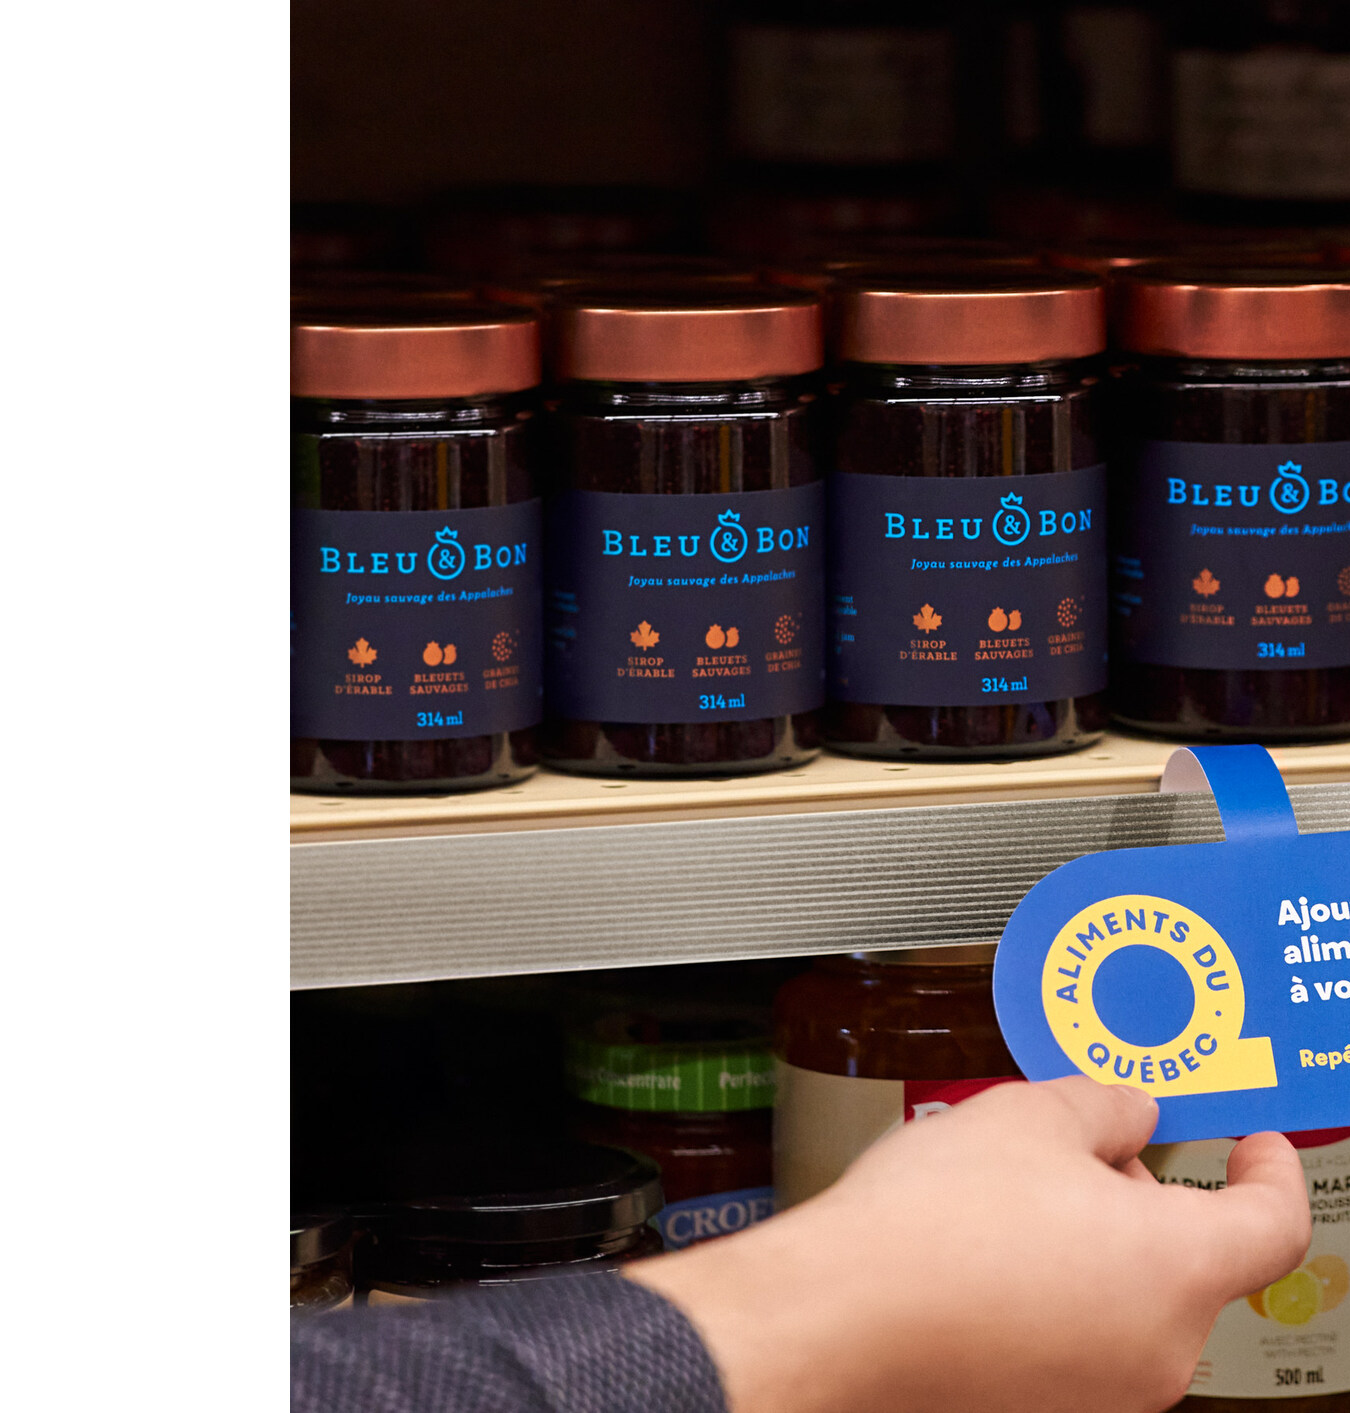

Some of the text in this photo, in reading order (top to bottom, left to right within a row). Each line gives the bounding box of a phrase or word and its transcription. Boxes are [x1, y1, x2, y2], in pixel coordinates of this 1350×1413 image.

[1166, 477, 1261, 507] BLEU
[884, 512, 983, 540] BLEU
[1039, 509, 1092, 536] BON
[602, 529, 700, 557] BLEU
[756, 526, 810, 554] BON
[320, 546, 418, 574] BLEU
[473, 543, 528, 571] BON
[911, 558, 946, 571] Joyau
[949, 559, 999, 571] sauvage
[1002, 556, 1021, 568] des
[628, 575, 664, 588] Joyau
[666, 576, 716, 588] sauvage
[719, 573, 739, 585] des
[346, 592, 381, 605] Joyau
[384, 592, 433, 605] sauvage
[437, 590, 456, 602] des
[910, 639, 947, 649] SIROP
[979, 637, 1031, 649] BLEUETS
[1257, 642, 1305, 658] 314 ml
[627, 656, 664, 667] SIROP
[696, 654, 748, 666] BLEUETS
[974, 649, 1034, 661] SAUVAGES
[344, 674, 382, 684] SIROP
[413, 671, 465, 683] BLEUETS
[692, 666, 751, 678] SAUVAGES
[409, 683, 469, 695] SAUVAGES
[981, 675, 1028, 693] 314 ml
[699, 693, 746, 710] 314 ml
[417, 710, 463, 727] 314 ml
[1056, 908, 1230, 1004] ALIMENTS DU
[1290, 975, 1310, 1004] à
[1087, 1033, 1218, 1083] QUÉBEC
[1275, 1367, 1302, 1386] 500
